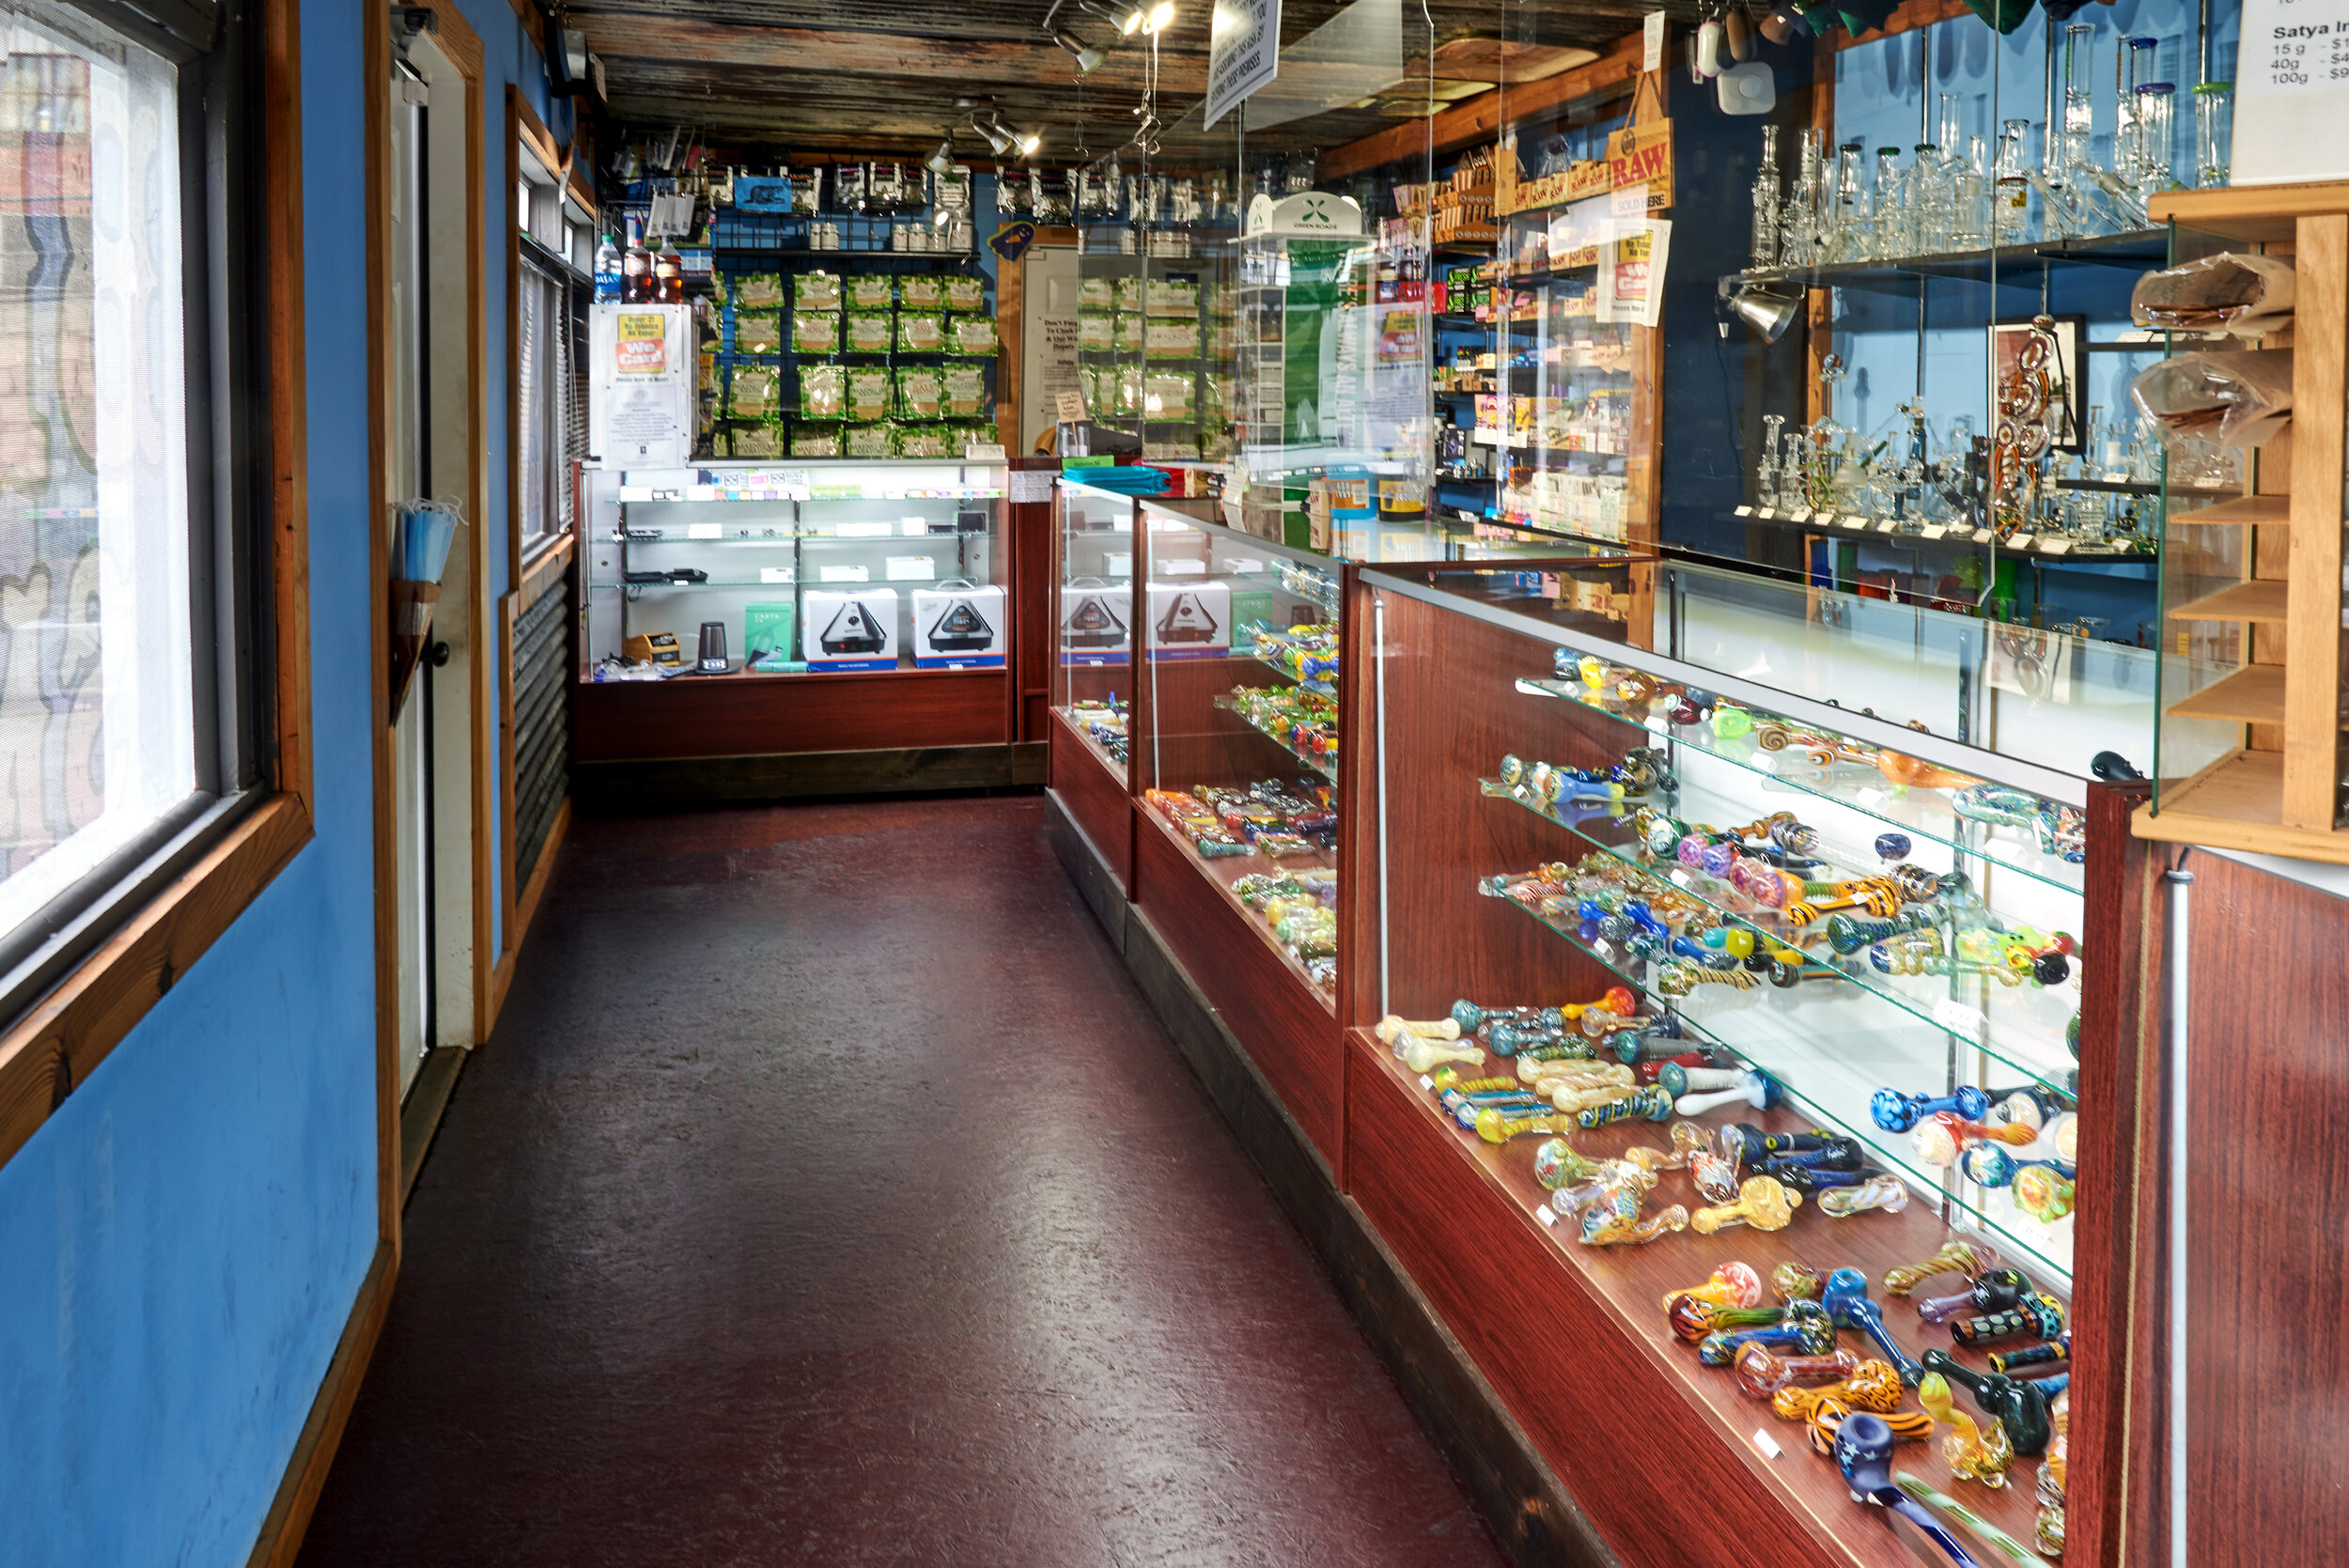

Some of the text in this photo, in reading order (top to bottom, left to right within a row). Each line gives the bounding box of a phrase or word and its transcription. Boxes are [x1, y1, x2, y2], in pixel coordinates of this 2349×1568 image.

[2274, 24, 2329, 39] Satya
[2274, 43, 2291, 55] 15
[2295, 44, 2306, 55] g
[2270, 58, 2300, 70] 40g
[2271, 72, 2309, 85] 100g
[1611, 142, 1668, 188] RAW
[1618, 194, 1666, 211] SOLD HERE
[1617, 276, 1647, 290] Car
[625, 341, 657, 355] We
[1336, 314, 1357, 371] ALWAYS
[618, 349, 663, 365] Card
[1336, 375, 1357, 394] AN
